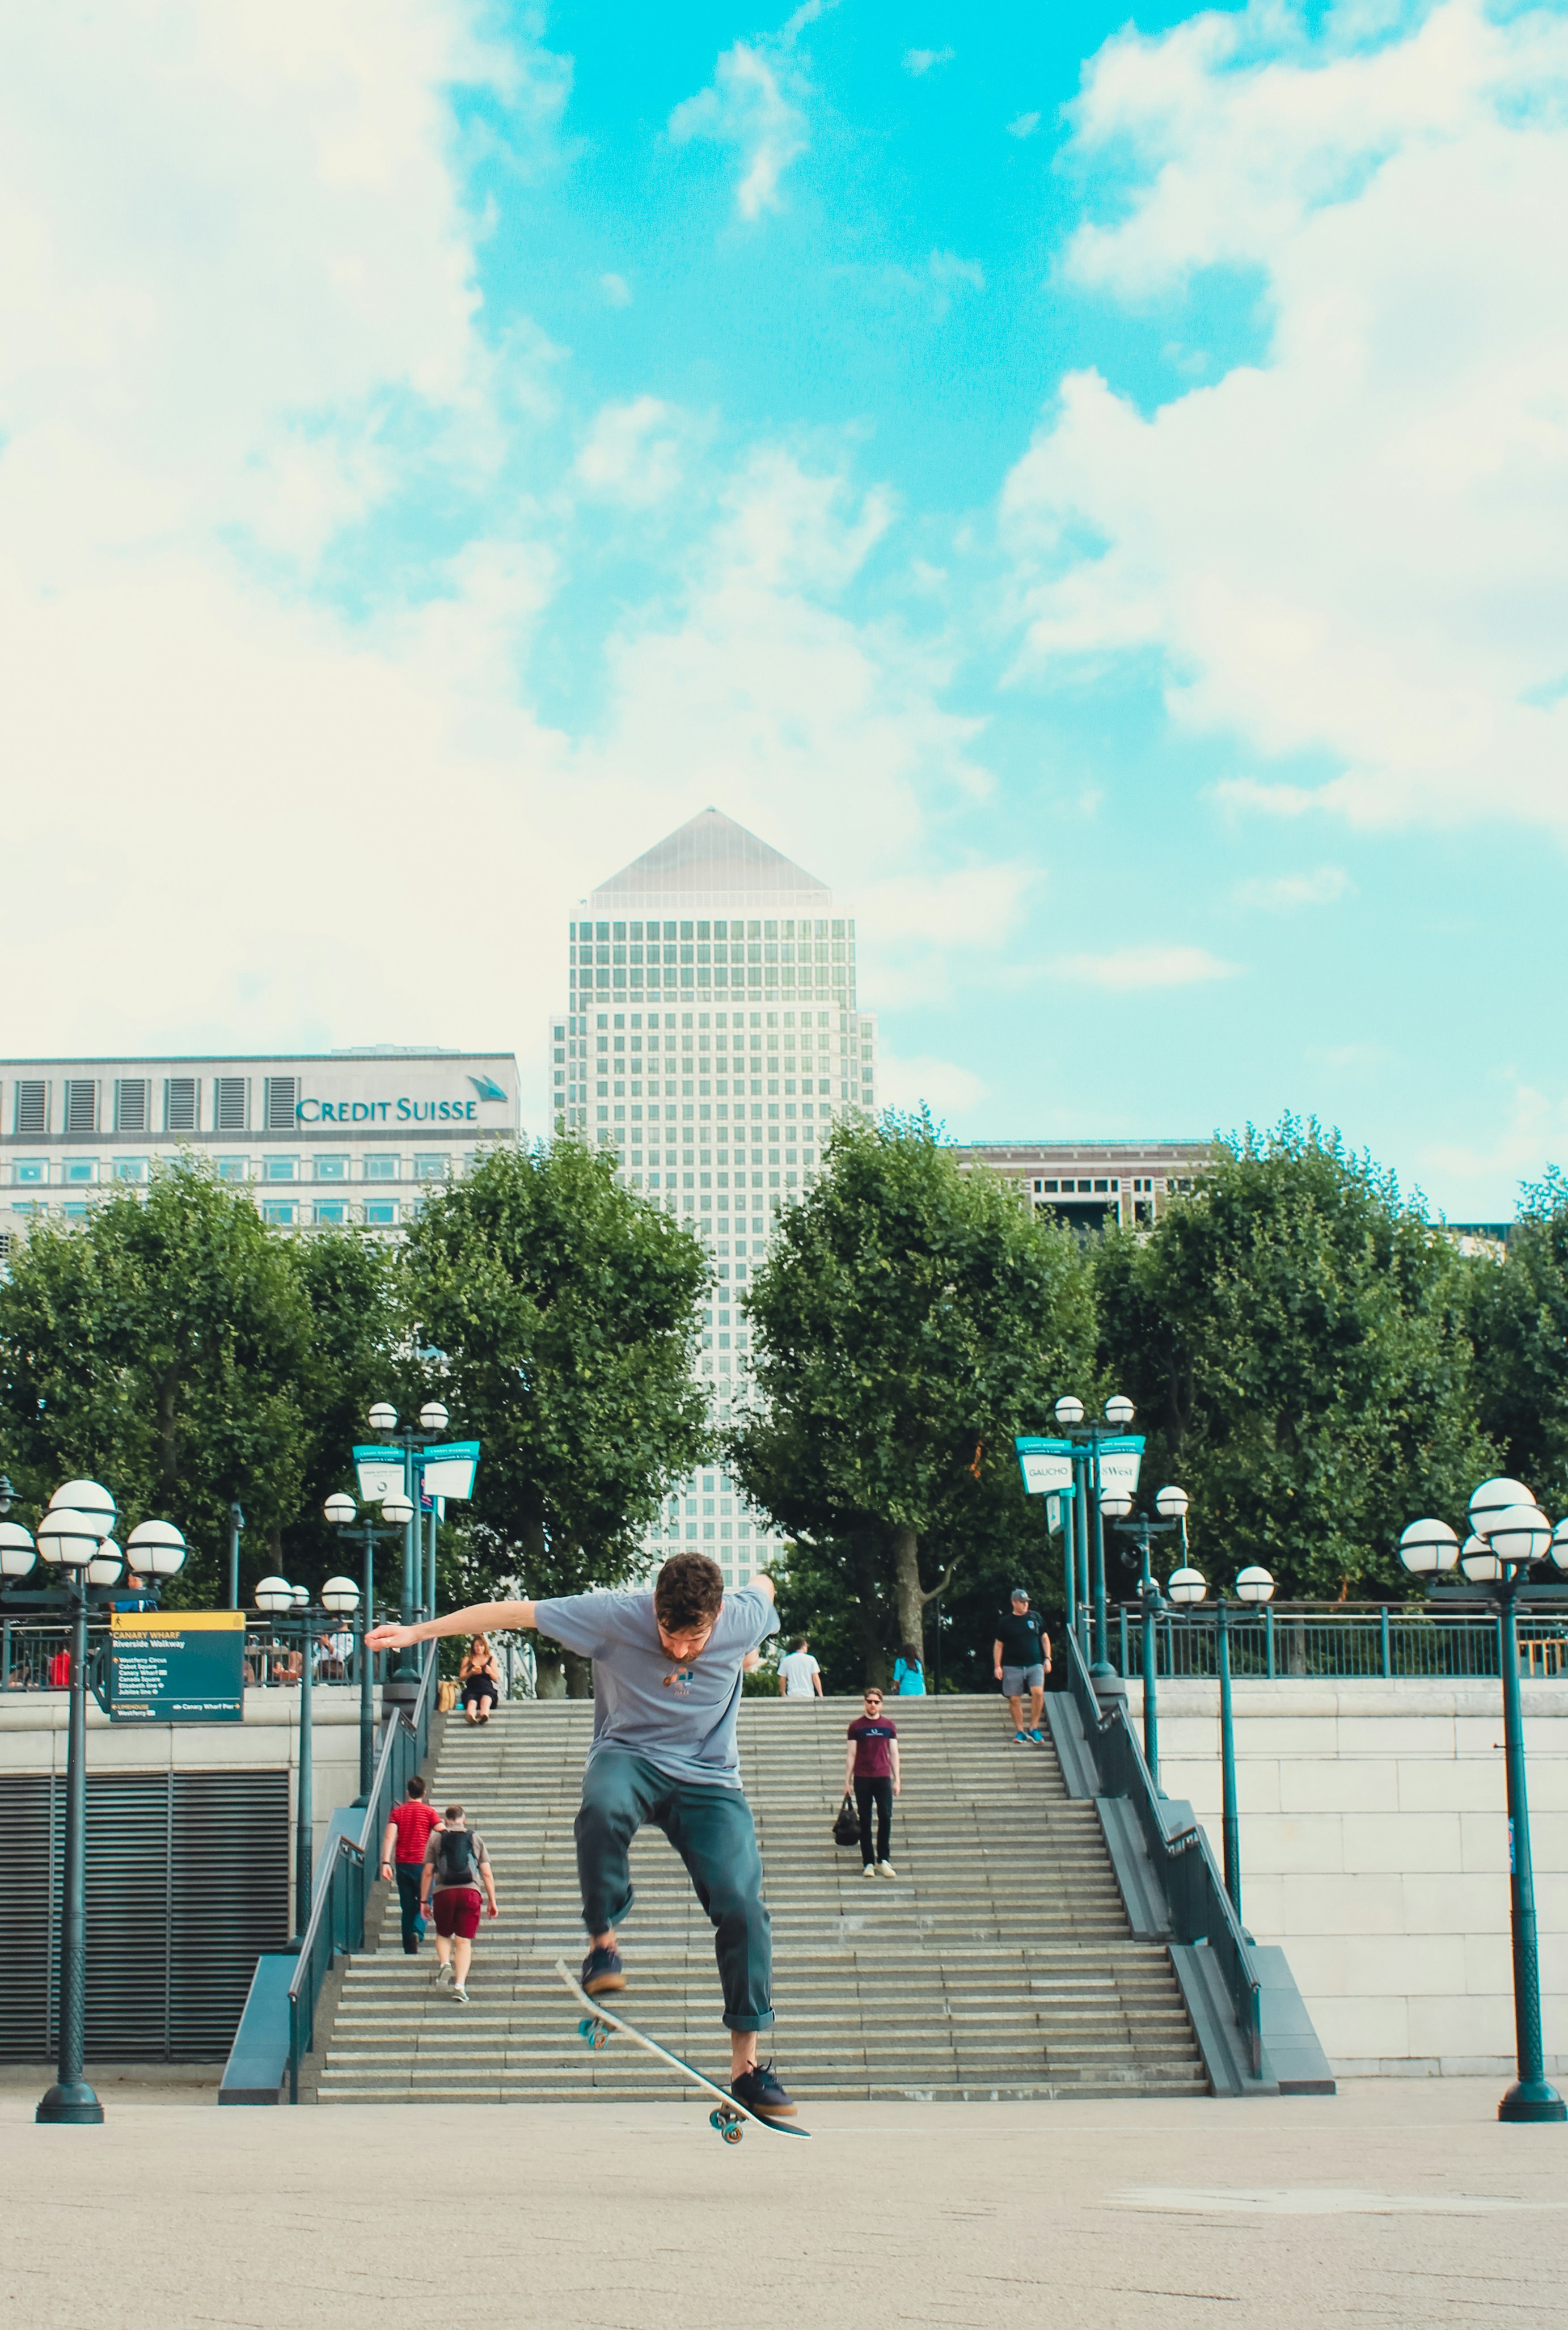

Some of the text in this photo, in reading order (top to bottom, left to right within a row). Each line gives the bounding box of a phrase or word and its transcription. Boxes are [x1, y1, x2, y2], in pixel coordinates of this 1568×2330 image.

[296, 1097, 477, 1122] CREDIT SUISSE
[1029, 1467, 1068, 1477] GAUCHO
[150, 1640, 185, 1649] Walkway
